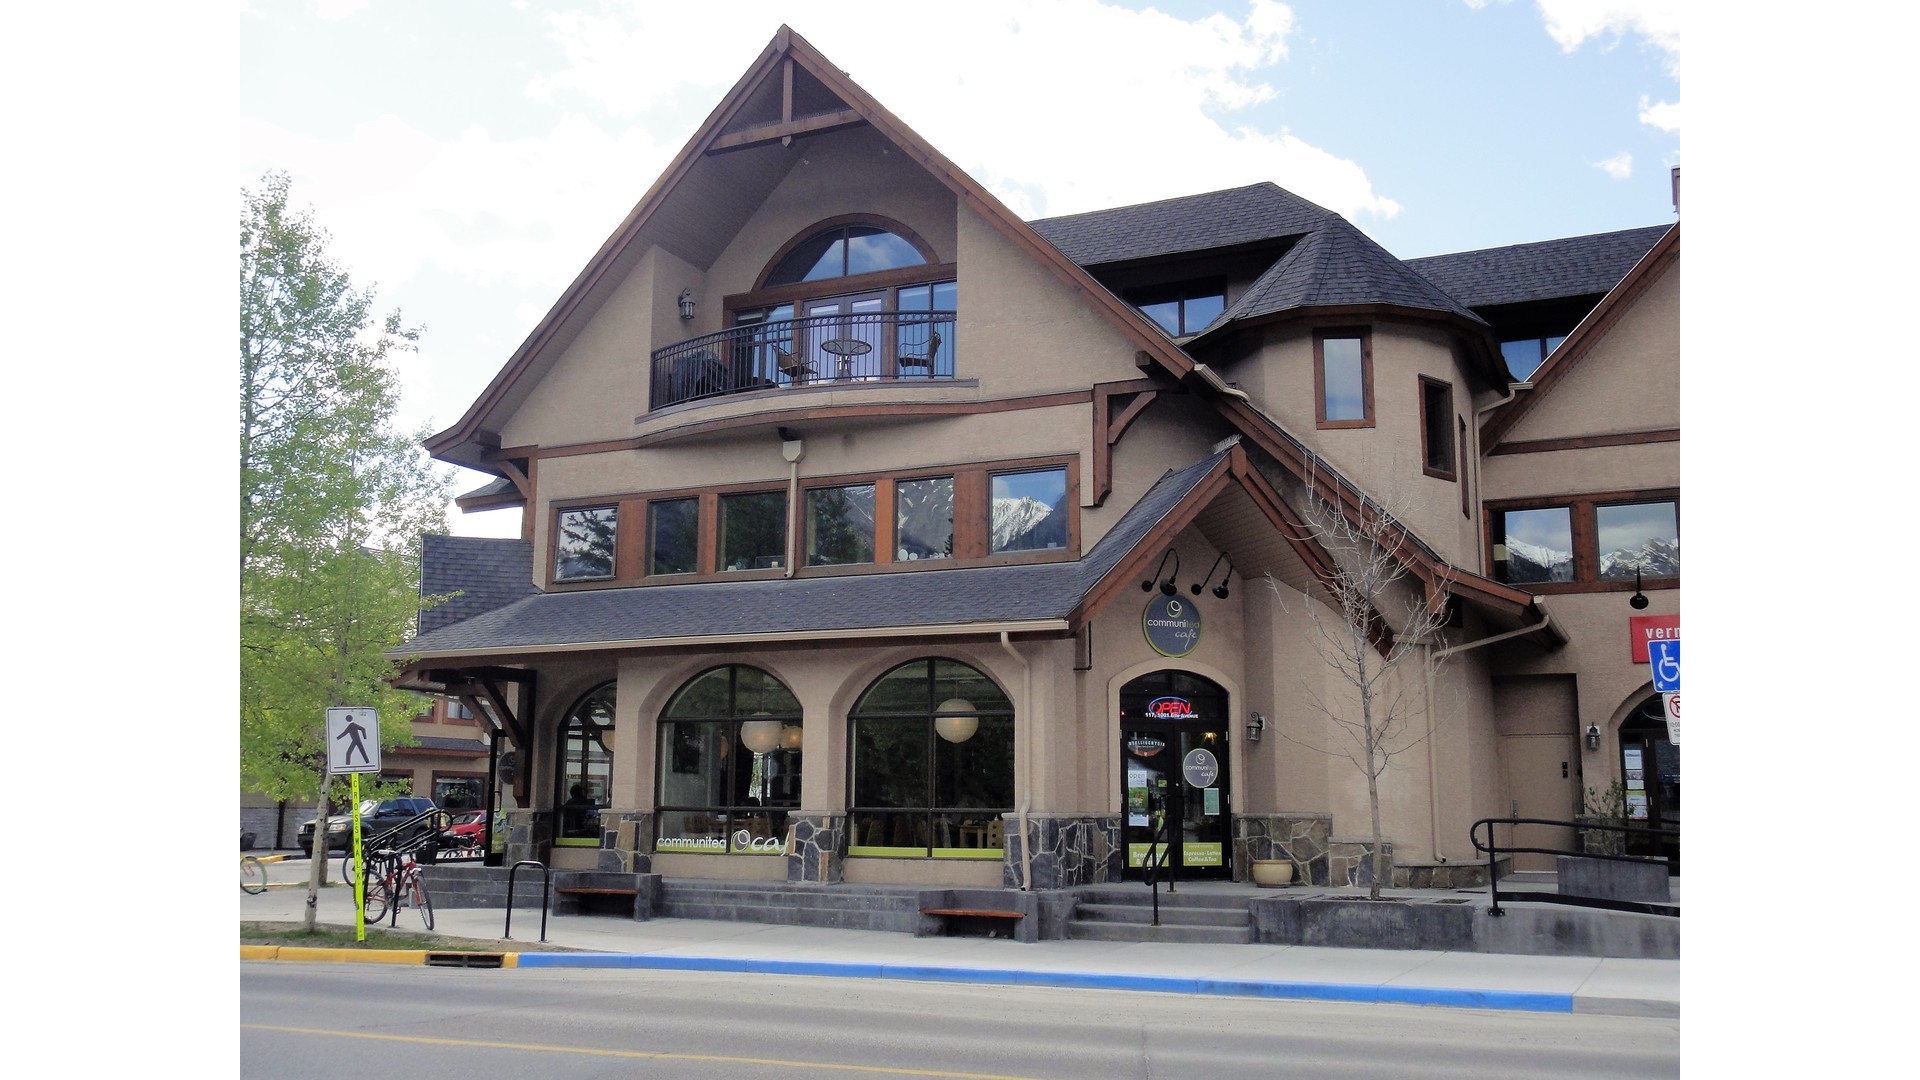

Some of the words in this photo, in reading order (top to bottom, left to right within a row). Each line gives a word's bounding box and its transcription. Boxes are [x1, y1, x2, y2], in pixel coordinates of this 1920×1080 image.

[1147, 620, 1200, 628] communitea
[1151, 701, 1191, 715] OPEN
[657, 836, 727, 849] communitea
